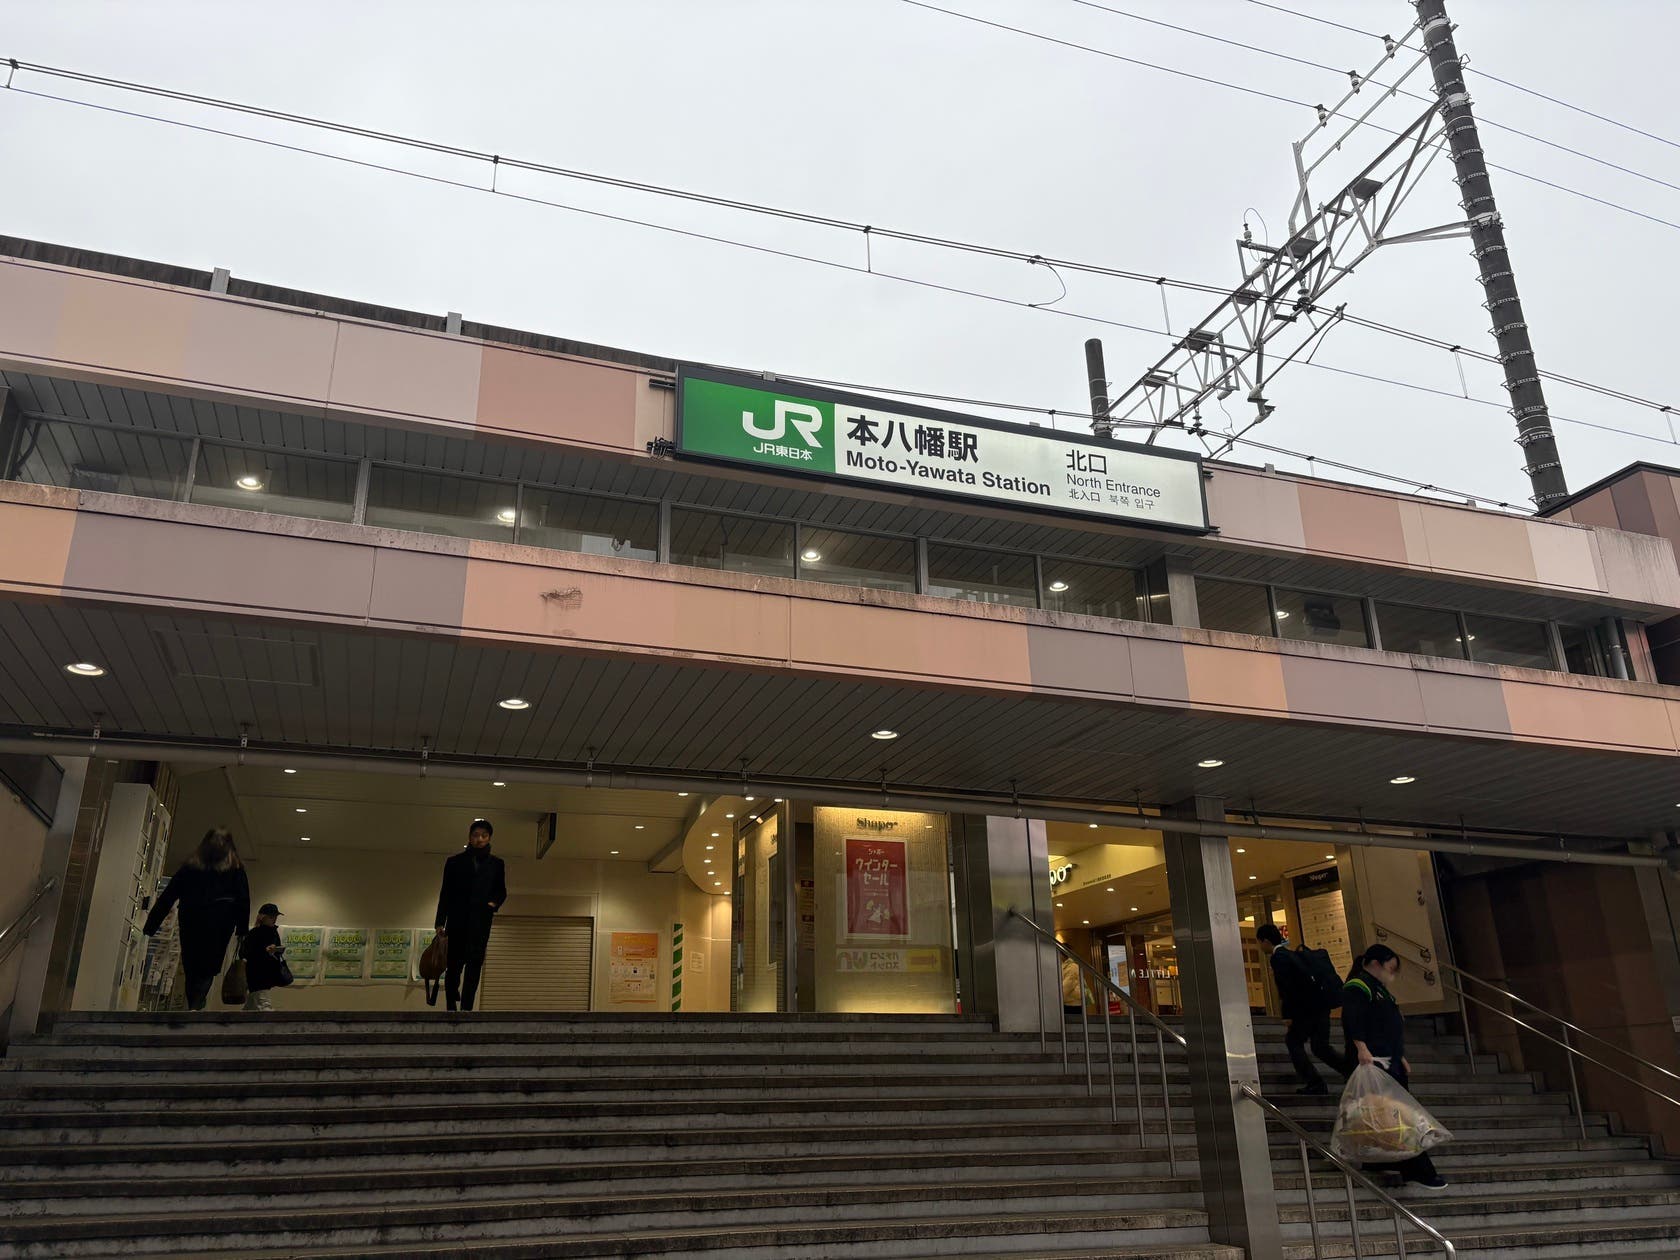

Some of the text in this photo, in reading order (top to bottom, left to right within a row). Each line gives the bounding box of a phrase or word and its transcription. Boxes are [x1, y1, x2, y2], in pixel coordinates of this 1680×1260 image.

[742, 400, 823, 449] JR
[753, 442, 813, 461] JR東日本
[847, 414, 979, 464] 本八幡駅
[846, 450, 1051, 497] Moto-Yawata Station
[1066, 449, 1107, 475] 北口
[1066, 473, 1161, 498] North Entrance
[1069, 488, 1101, 502] 北入口
[1109, 494, 1155, 510] 북쪽 입구
[864, 872, 889, 886] セール
